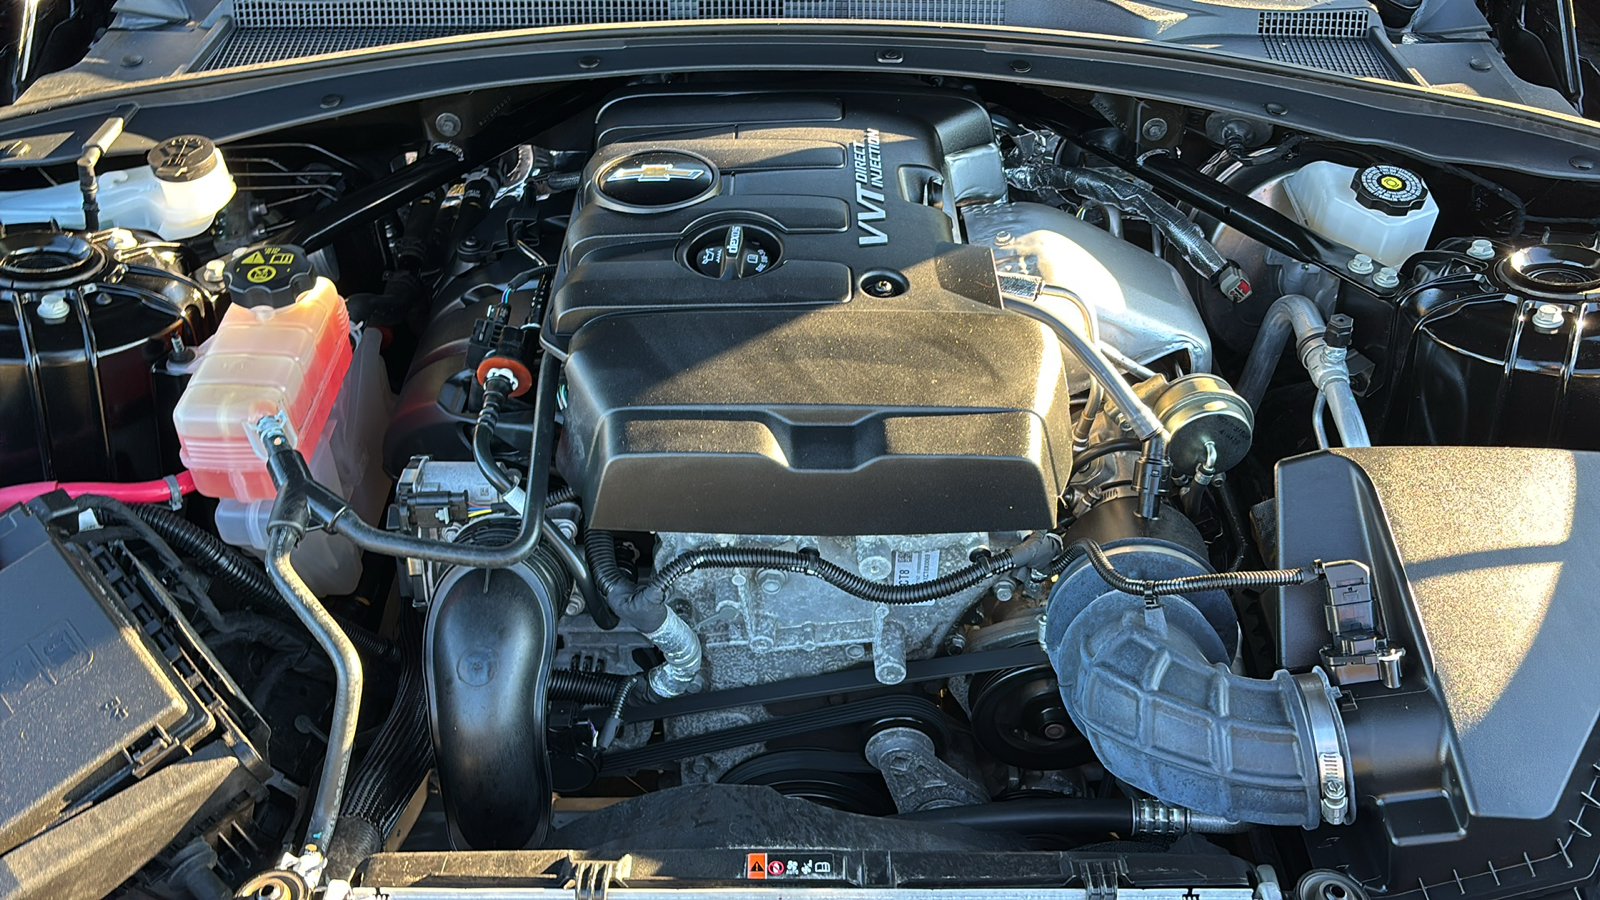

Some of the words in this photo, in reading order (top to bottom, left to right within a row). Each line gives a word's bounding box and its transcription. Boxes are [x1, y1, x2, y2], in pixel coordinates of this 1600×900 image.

[852, 139, 868, 183] DIRECT
[866, 127, 884, 188] INJECTION
[727, 225, 741, 253] dexos
[856, 182, 889, 246] VVT
